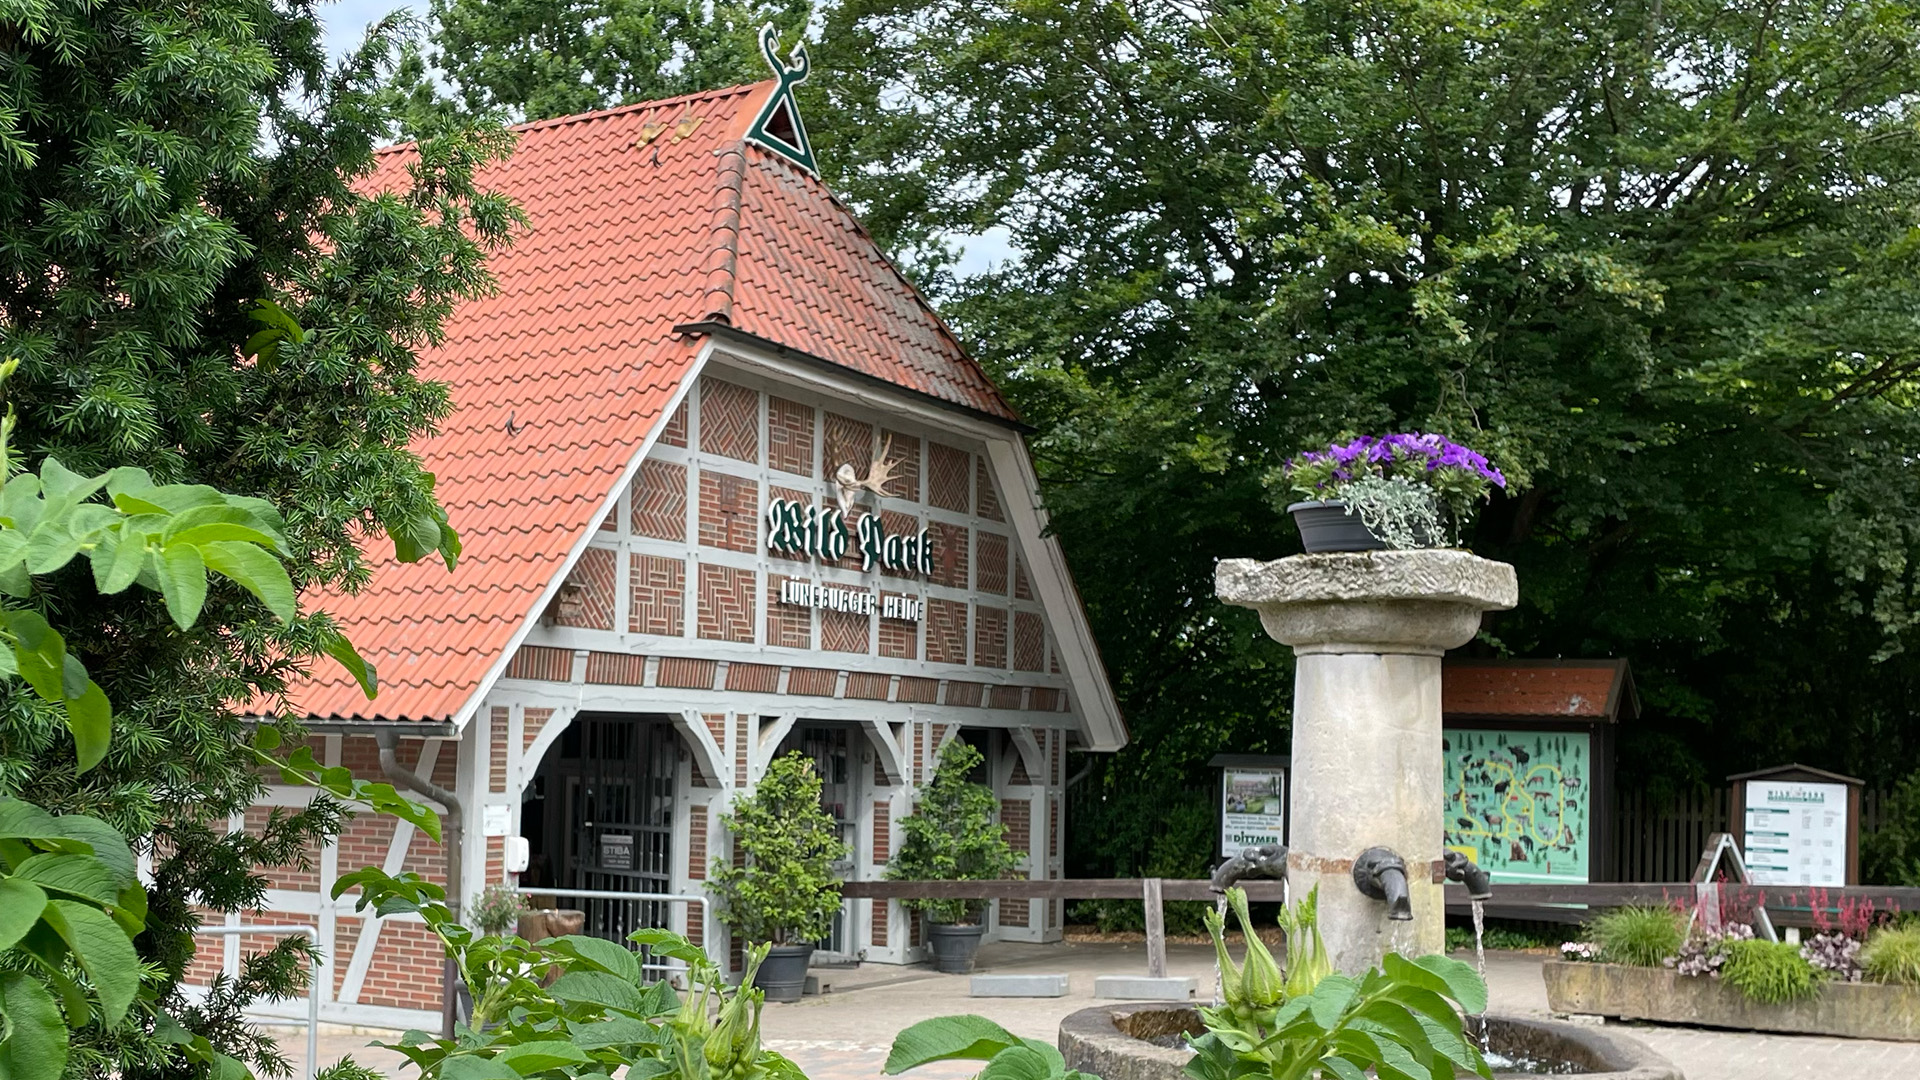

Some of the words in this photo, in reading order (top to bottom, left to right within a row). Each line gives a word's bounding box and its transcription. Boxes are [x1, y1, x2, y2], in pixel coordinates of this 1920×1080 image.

[767, 497, 849, 561] Wild
[857, 512, 935, 575] Park
[781, 575, 877, 615] LÜNEBURGER
[883, 592, 924, 621] HEIDE
